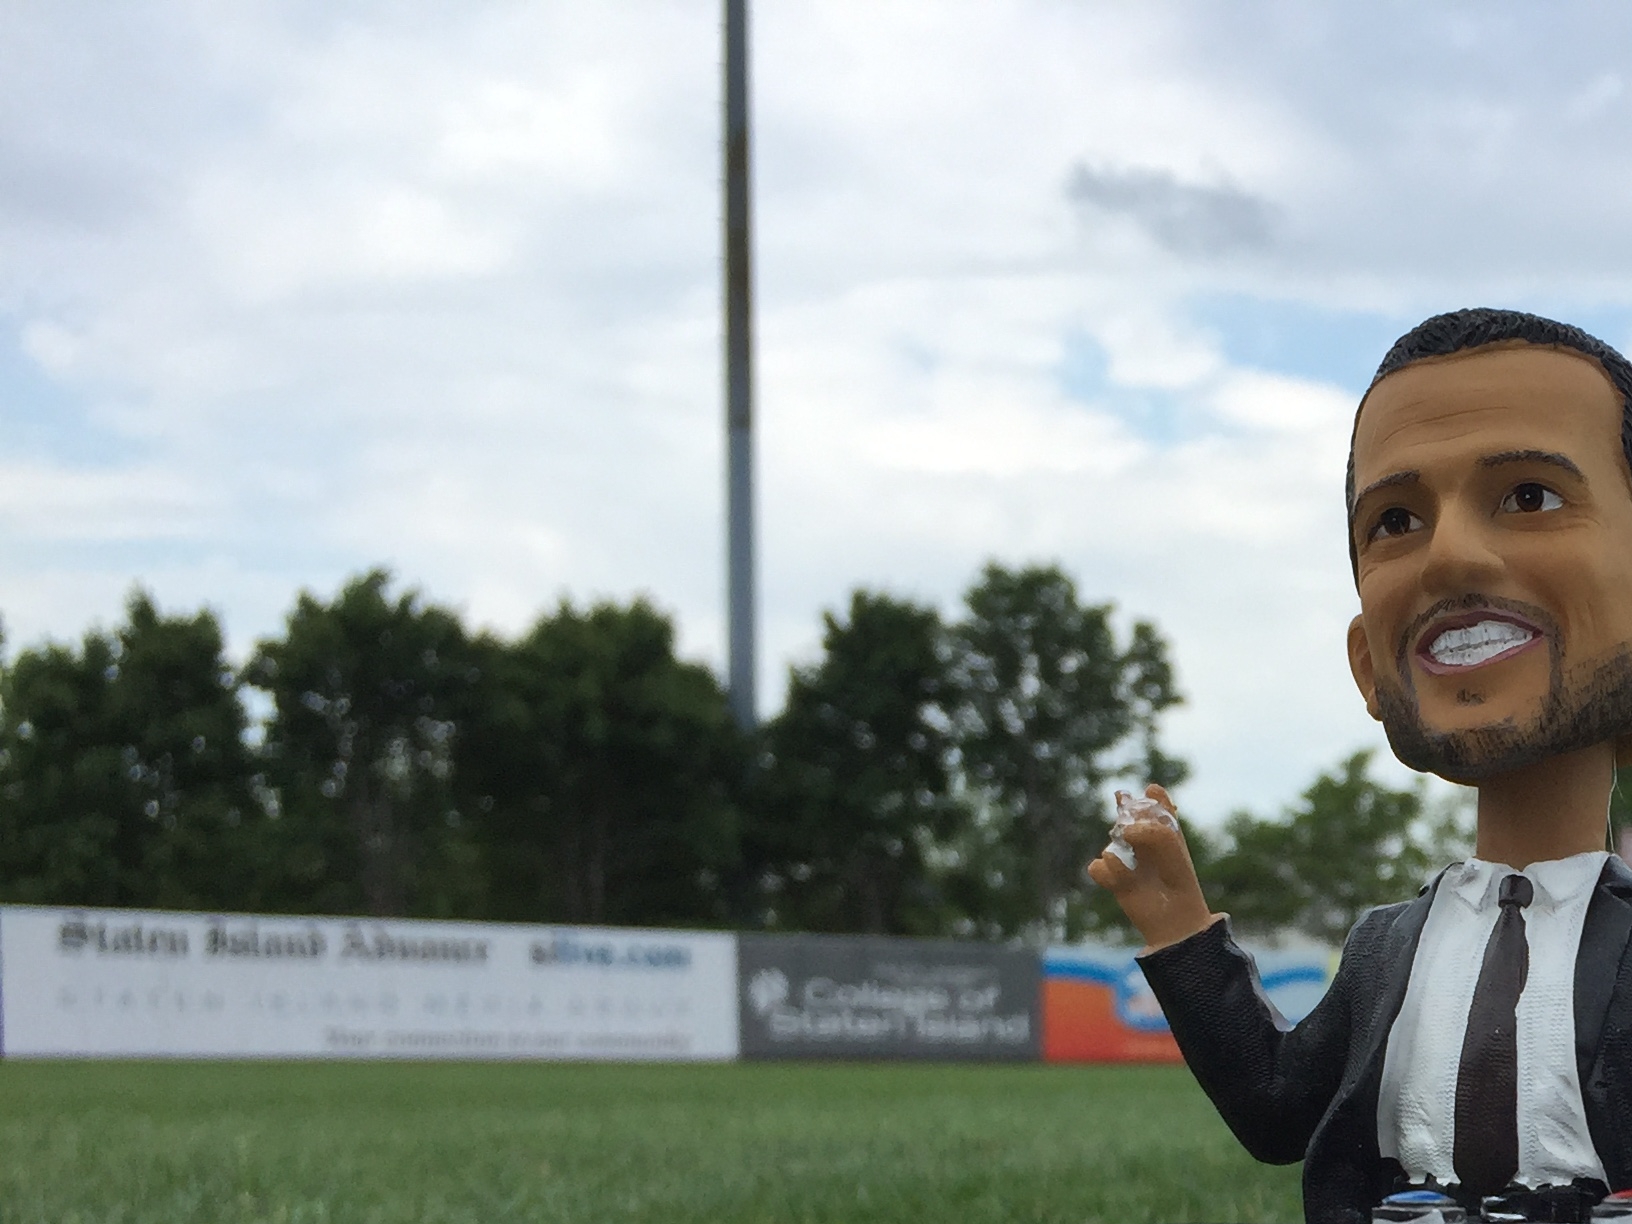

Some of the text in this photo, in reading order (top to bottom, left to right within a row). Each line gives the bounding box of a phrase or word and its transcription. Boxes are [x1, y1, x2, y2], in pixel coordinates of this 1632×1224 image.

[58, 912, 190, 957] Staten
[203, 915, 328, 960] Island
[803, 976, 1000, 1017] College of
[769, 1007, 1031, 1043] Staten Island
